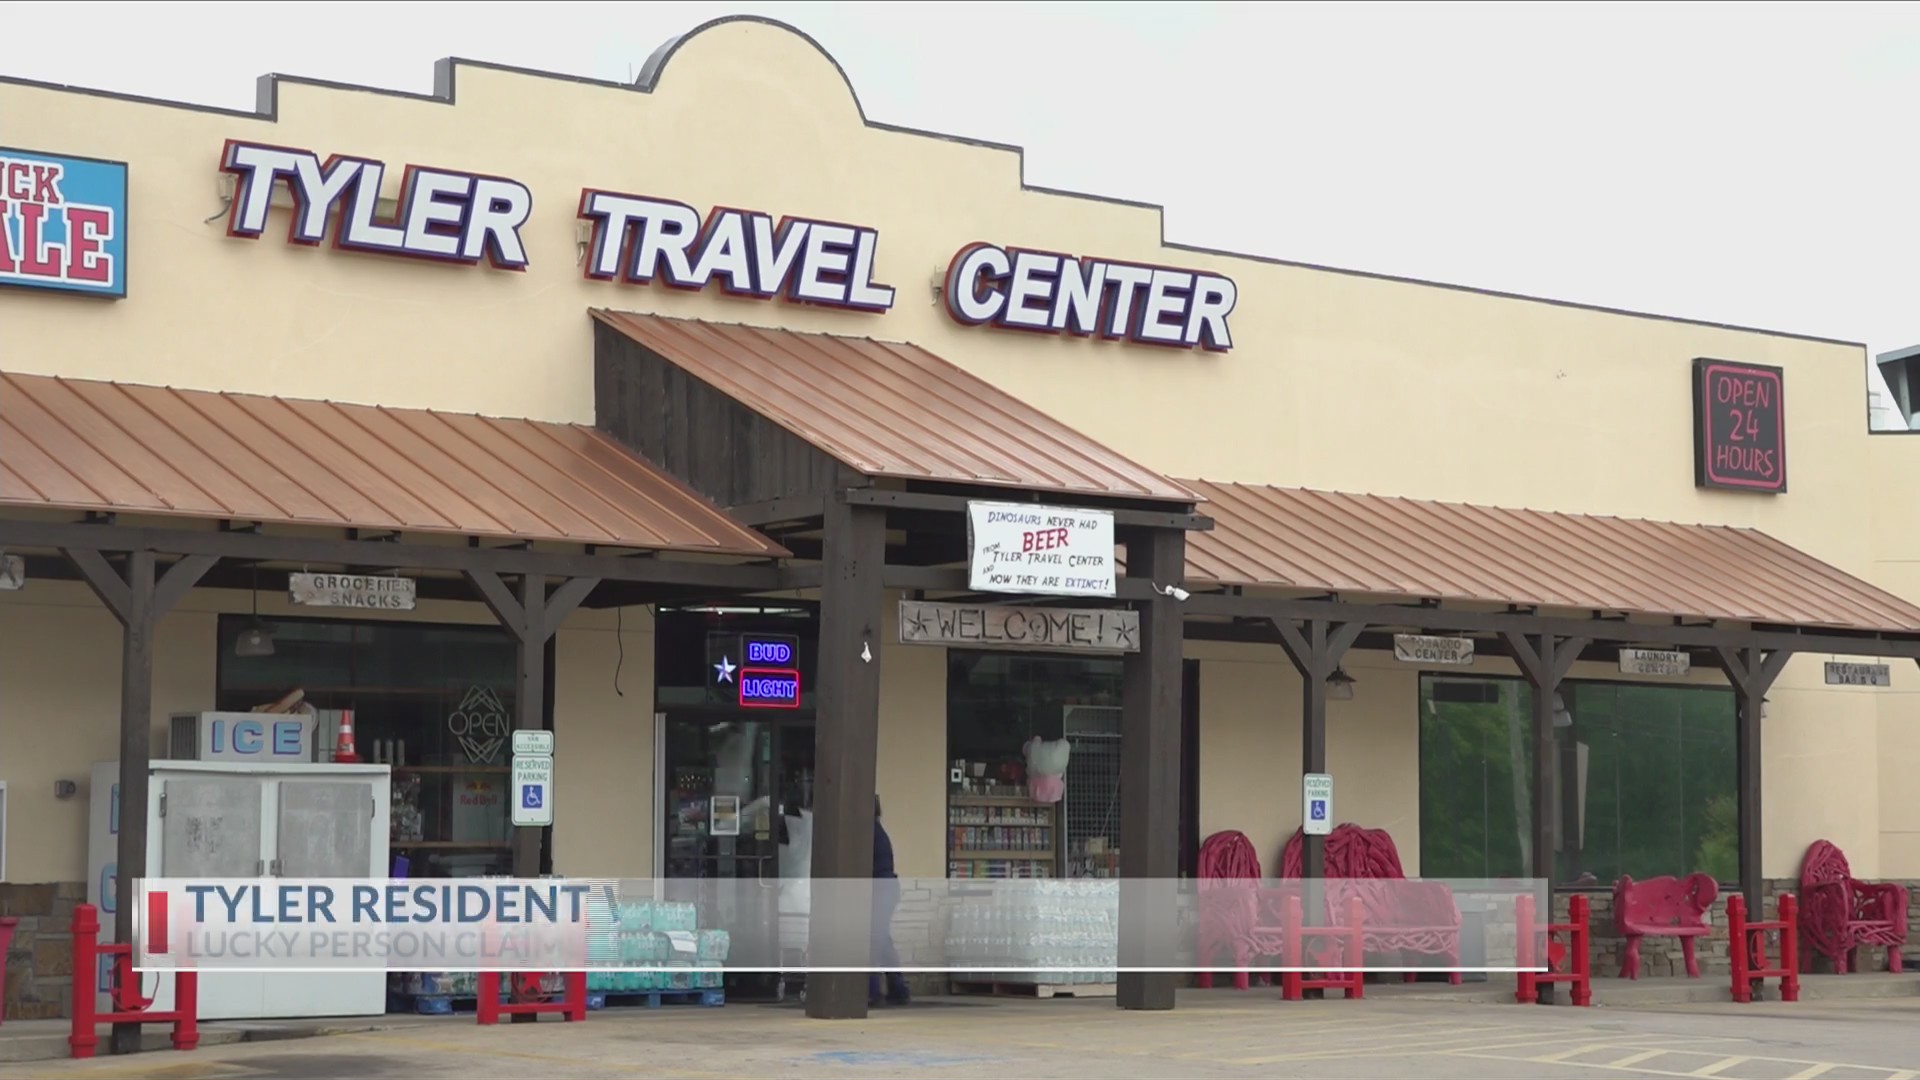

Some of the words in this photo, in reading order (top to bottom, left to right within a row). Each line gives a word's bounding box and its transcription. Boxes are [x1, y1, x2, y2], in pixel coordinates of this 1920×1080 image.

[226, 142, 530, 270] TYLER
[584, 191, 895, 311] TRAVEL
[948, 243, 1237, 351] CENTER
[1718, 376, 1770, 408] OPEN
[1729, 408, 1759, 441] 24
[1716, 445, 1774, 478] HOURS
[987, 511, 1041, 525] DINOSAURS
[1047, 516, 1075, 528] NEVER
[1079, 519, 1098, 530] HAD
[982, 541, 1001, 555] FROM
[1022, 527, 1069, 552] BEER
[993, 551, 1022, 563] TYLER
[1028, 552, 1063, 565] TRAVEL
[1068, 555, 1104, 568] CENTER
[982, 564, 995, 575] AND
[313, 576, 410, 592] GROCERIES
[989, 574, 1012, 585] NOW
[1016, 574, 1038, 586] THEY
[1042, 576, 1060, 588] ARE
[330, 591, 401, 607] SNACKS
[936, 608, 1103, 645] WELCOME!
[749, 642, 791, 662] BUD
[1415, 648, 1458, 661] CENTER
[1634, 650, 1679, 662] LAUNDRY
[743, 678, 797, 698] LIGHT
[448, 711, 510, 736] OPEN
[211, 720, 303, 755] ICE
[515, 760, 549, 770] RESERVED
[518, 771, 548, 782] PARKING
